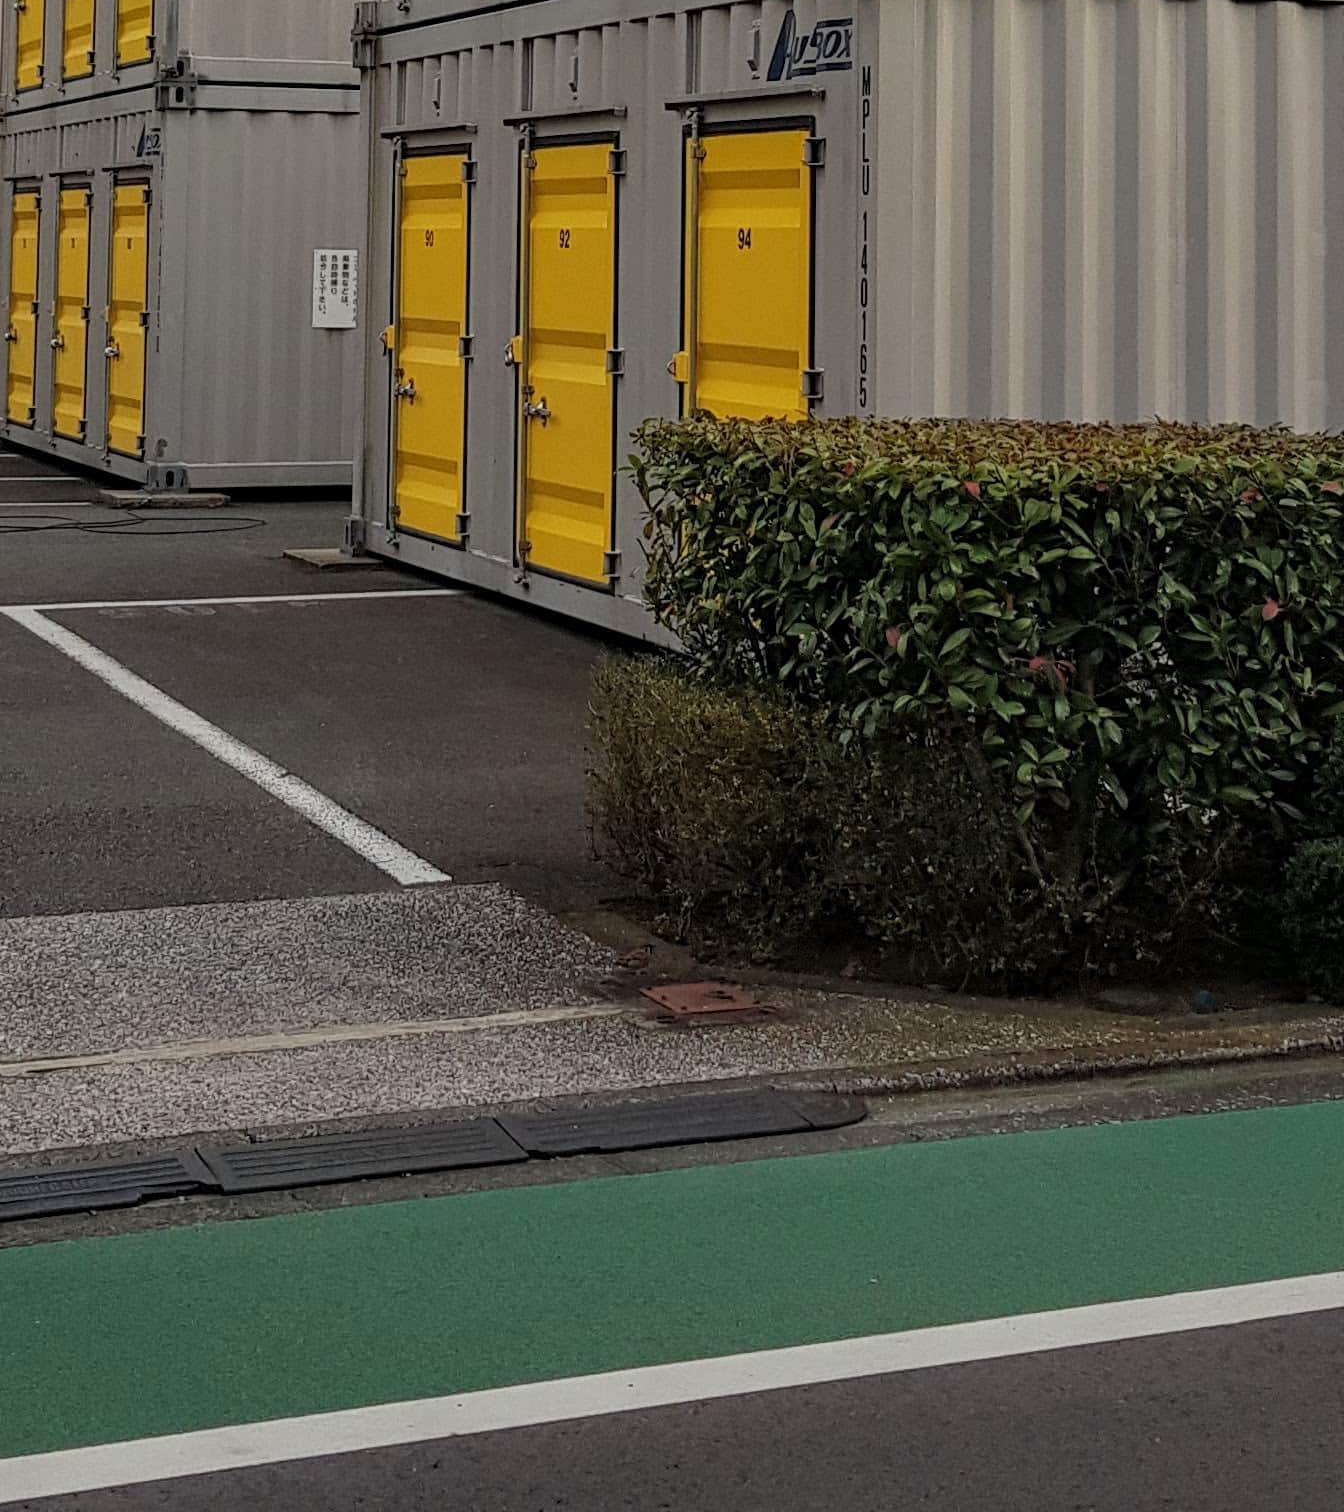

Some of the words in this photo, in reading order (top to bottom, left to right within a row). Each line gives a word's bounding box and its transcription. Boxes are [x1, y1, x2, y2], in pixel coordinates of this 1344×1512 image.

[860, 66, 871, 196] MPLU
[425, 230, 434, 247] 90
[559, 229, 570, 249] 92
[737, 227, 751, 250] 94
[858, 211, 869, 408] 140165
